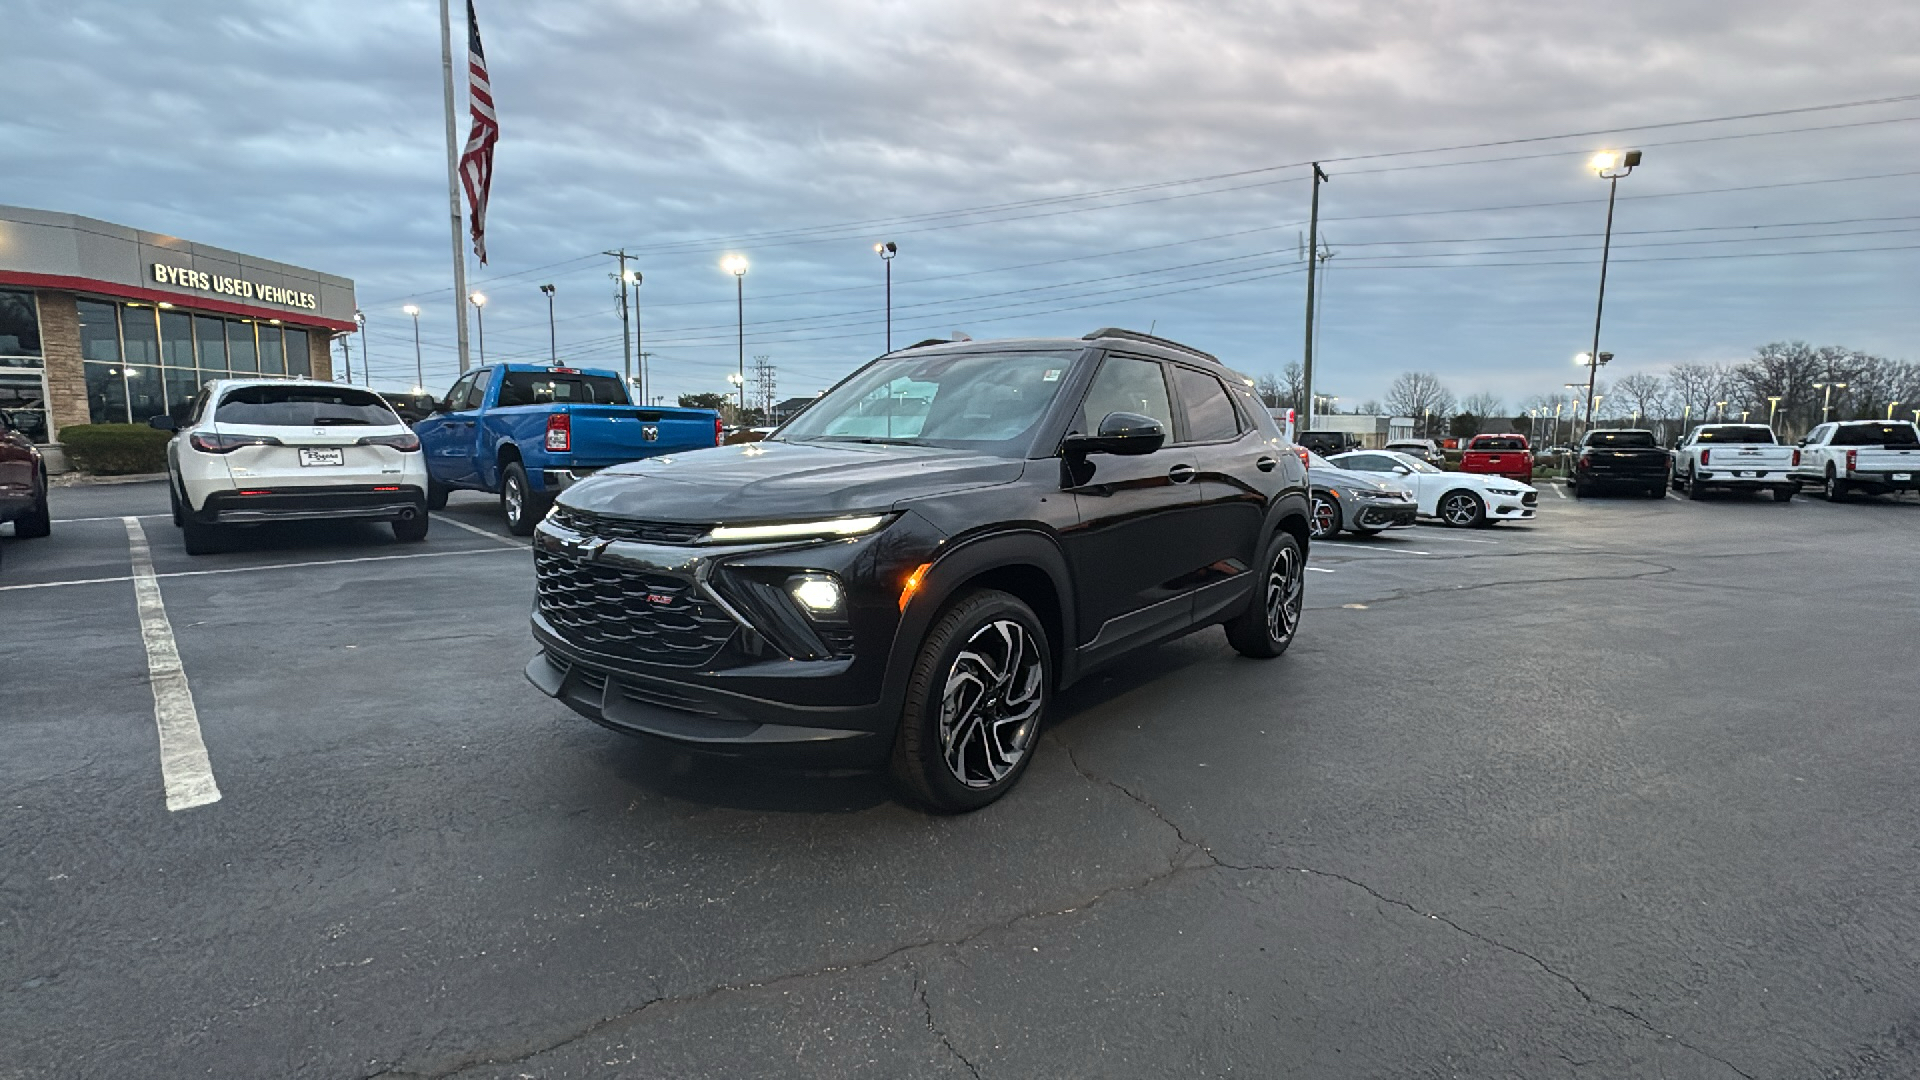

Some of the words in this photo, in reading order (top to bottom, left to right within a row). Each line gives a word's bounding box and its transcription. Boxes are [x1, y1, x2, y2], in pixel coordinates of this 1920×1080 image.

[154, 263, 210, 291] BYERS
[213, 275, 251, 299] USED
[254, 283, 316, 310] VEHICLES
